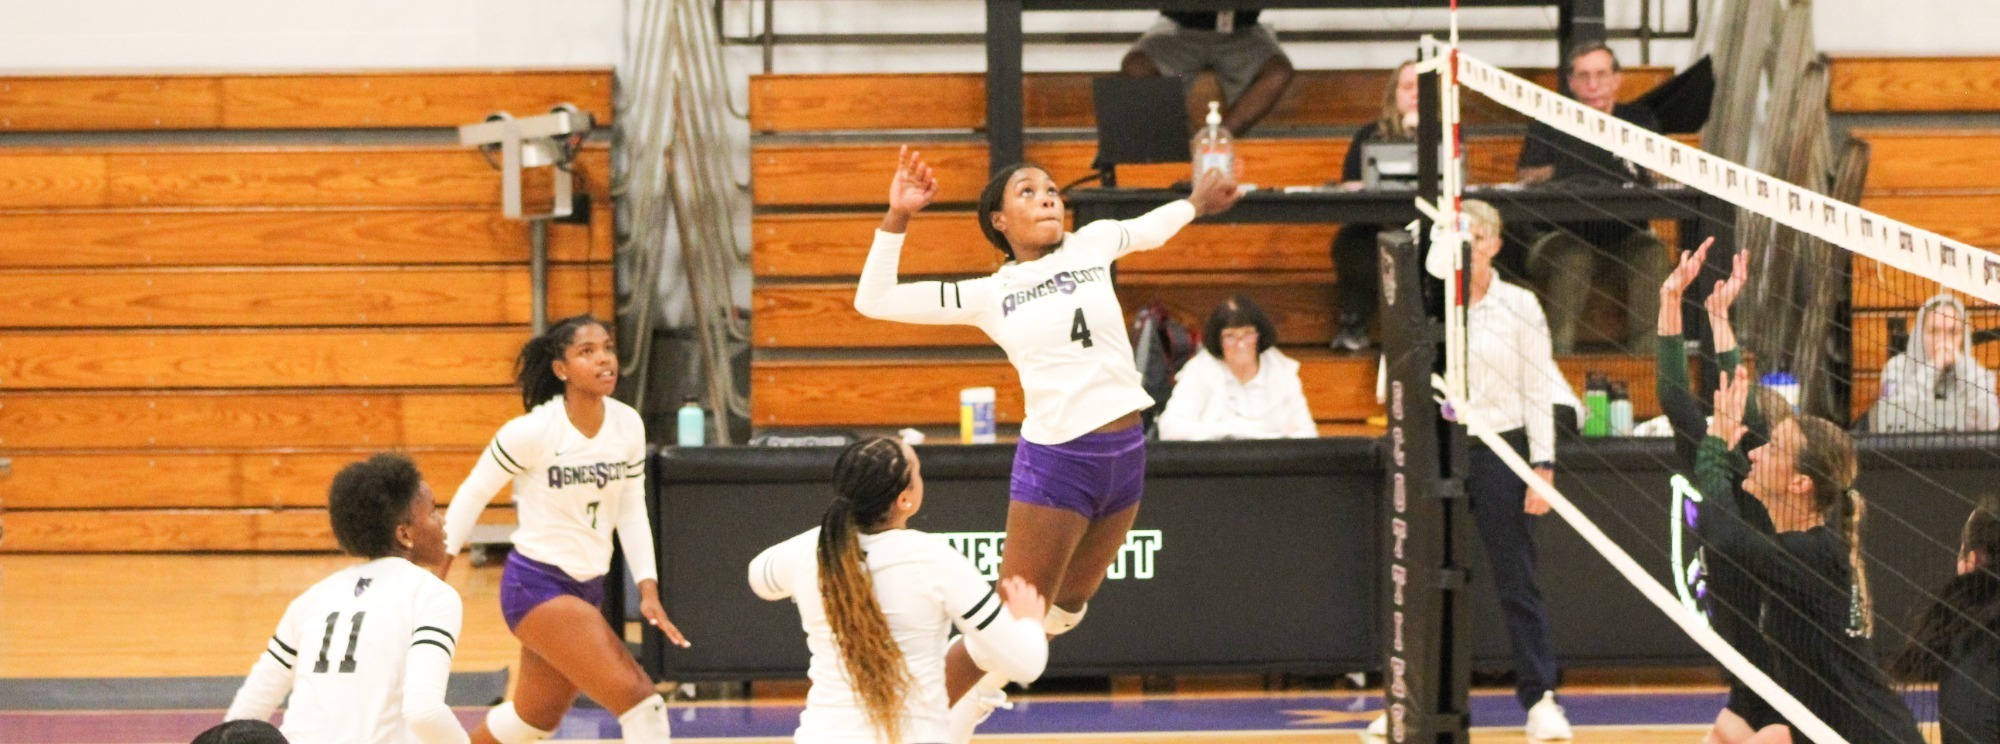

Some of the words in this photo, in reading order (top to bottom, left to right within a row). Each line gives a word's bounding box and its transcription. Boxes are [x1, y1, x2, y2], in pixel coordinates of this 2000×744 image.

[1071, 307, 1093, 348] 4
[586, 500, 600, 529] 7
[313, 611, 366, 673] 11
